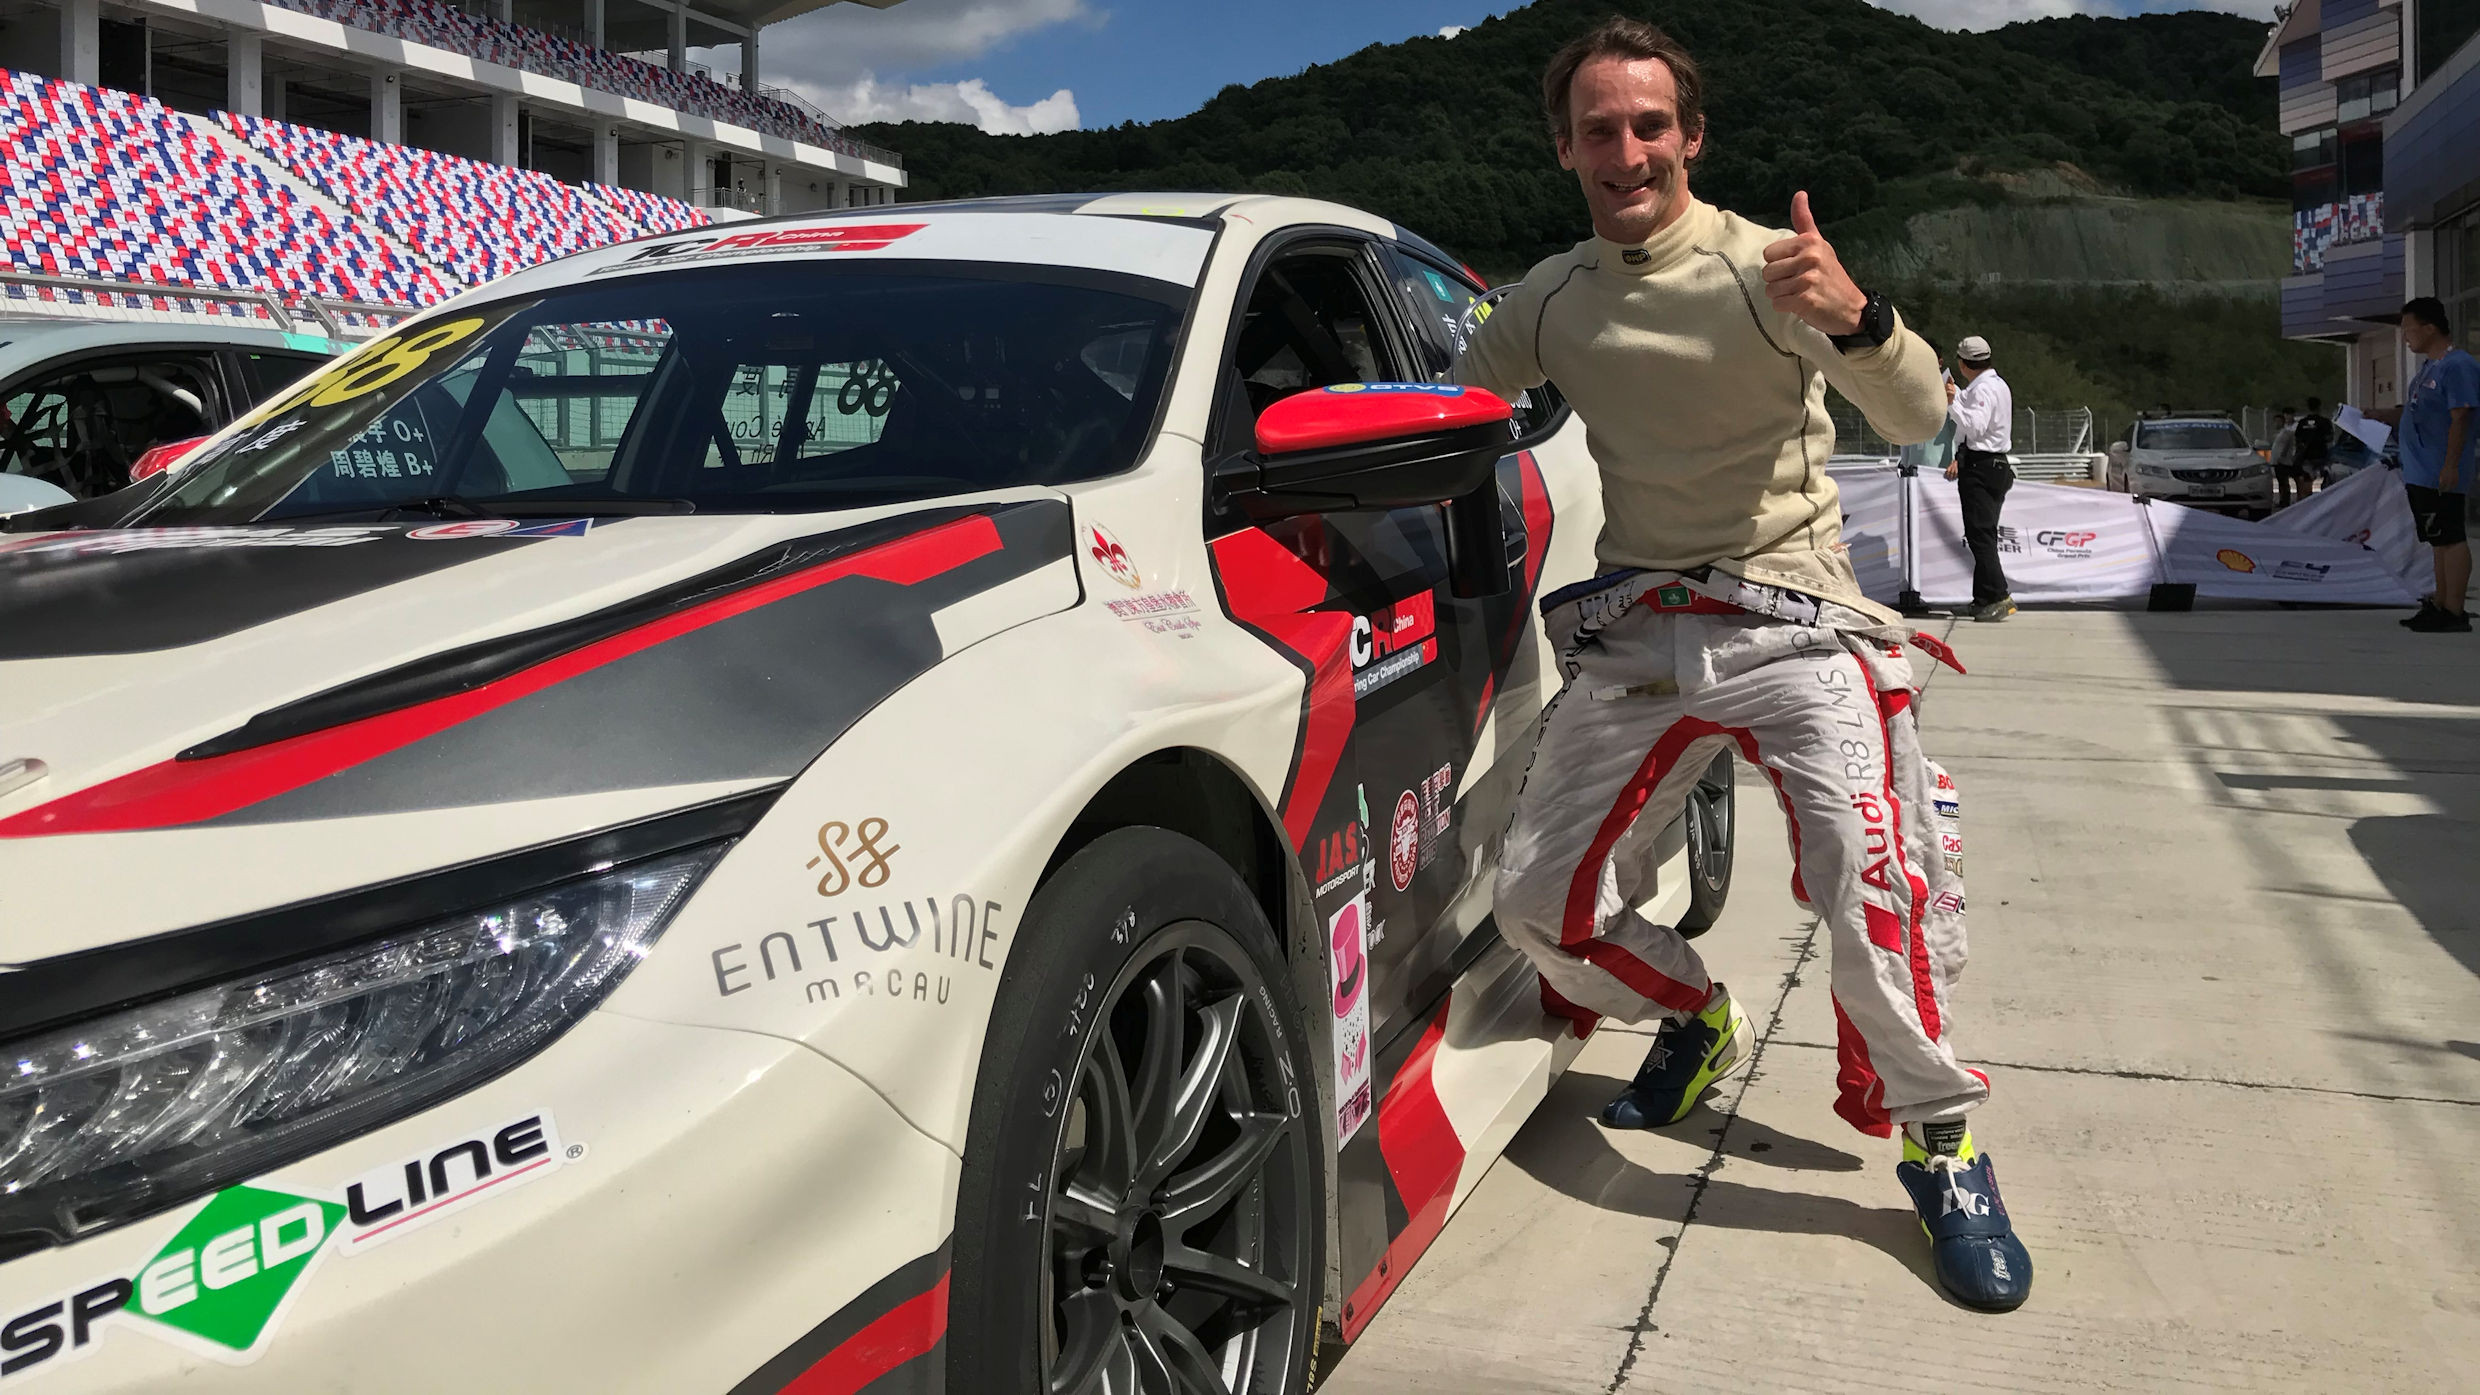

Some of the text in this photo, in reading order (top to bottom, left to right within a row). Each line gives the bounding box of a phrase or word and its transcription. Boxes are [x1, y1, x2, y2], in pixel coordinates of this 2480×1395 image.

[776, 230, 845, 240] China
[406, 452, 434, 476] B+
[2037, 530, 2097, 548] CFGP
[1392, 614, 1415, 634] China
[1366, 671, 1380, 686] Car
[1379, 650, 1421, 680] Championship
[1815, 667, 1858, 729] LMS
[1839, 739, 1876, 781] R8
[1850, 791, 1892, 893] Audi
[1315, 864, 1360, 899] MOTORSPORT
[1259, 985, 1283, 1039] RACING
